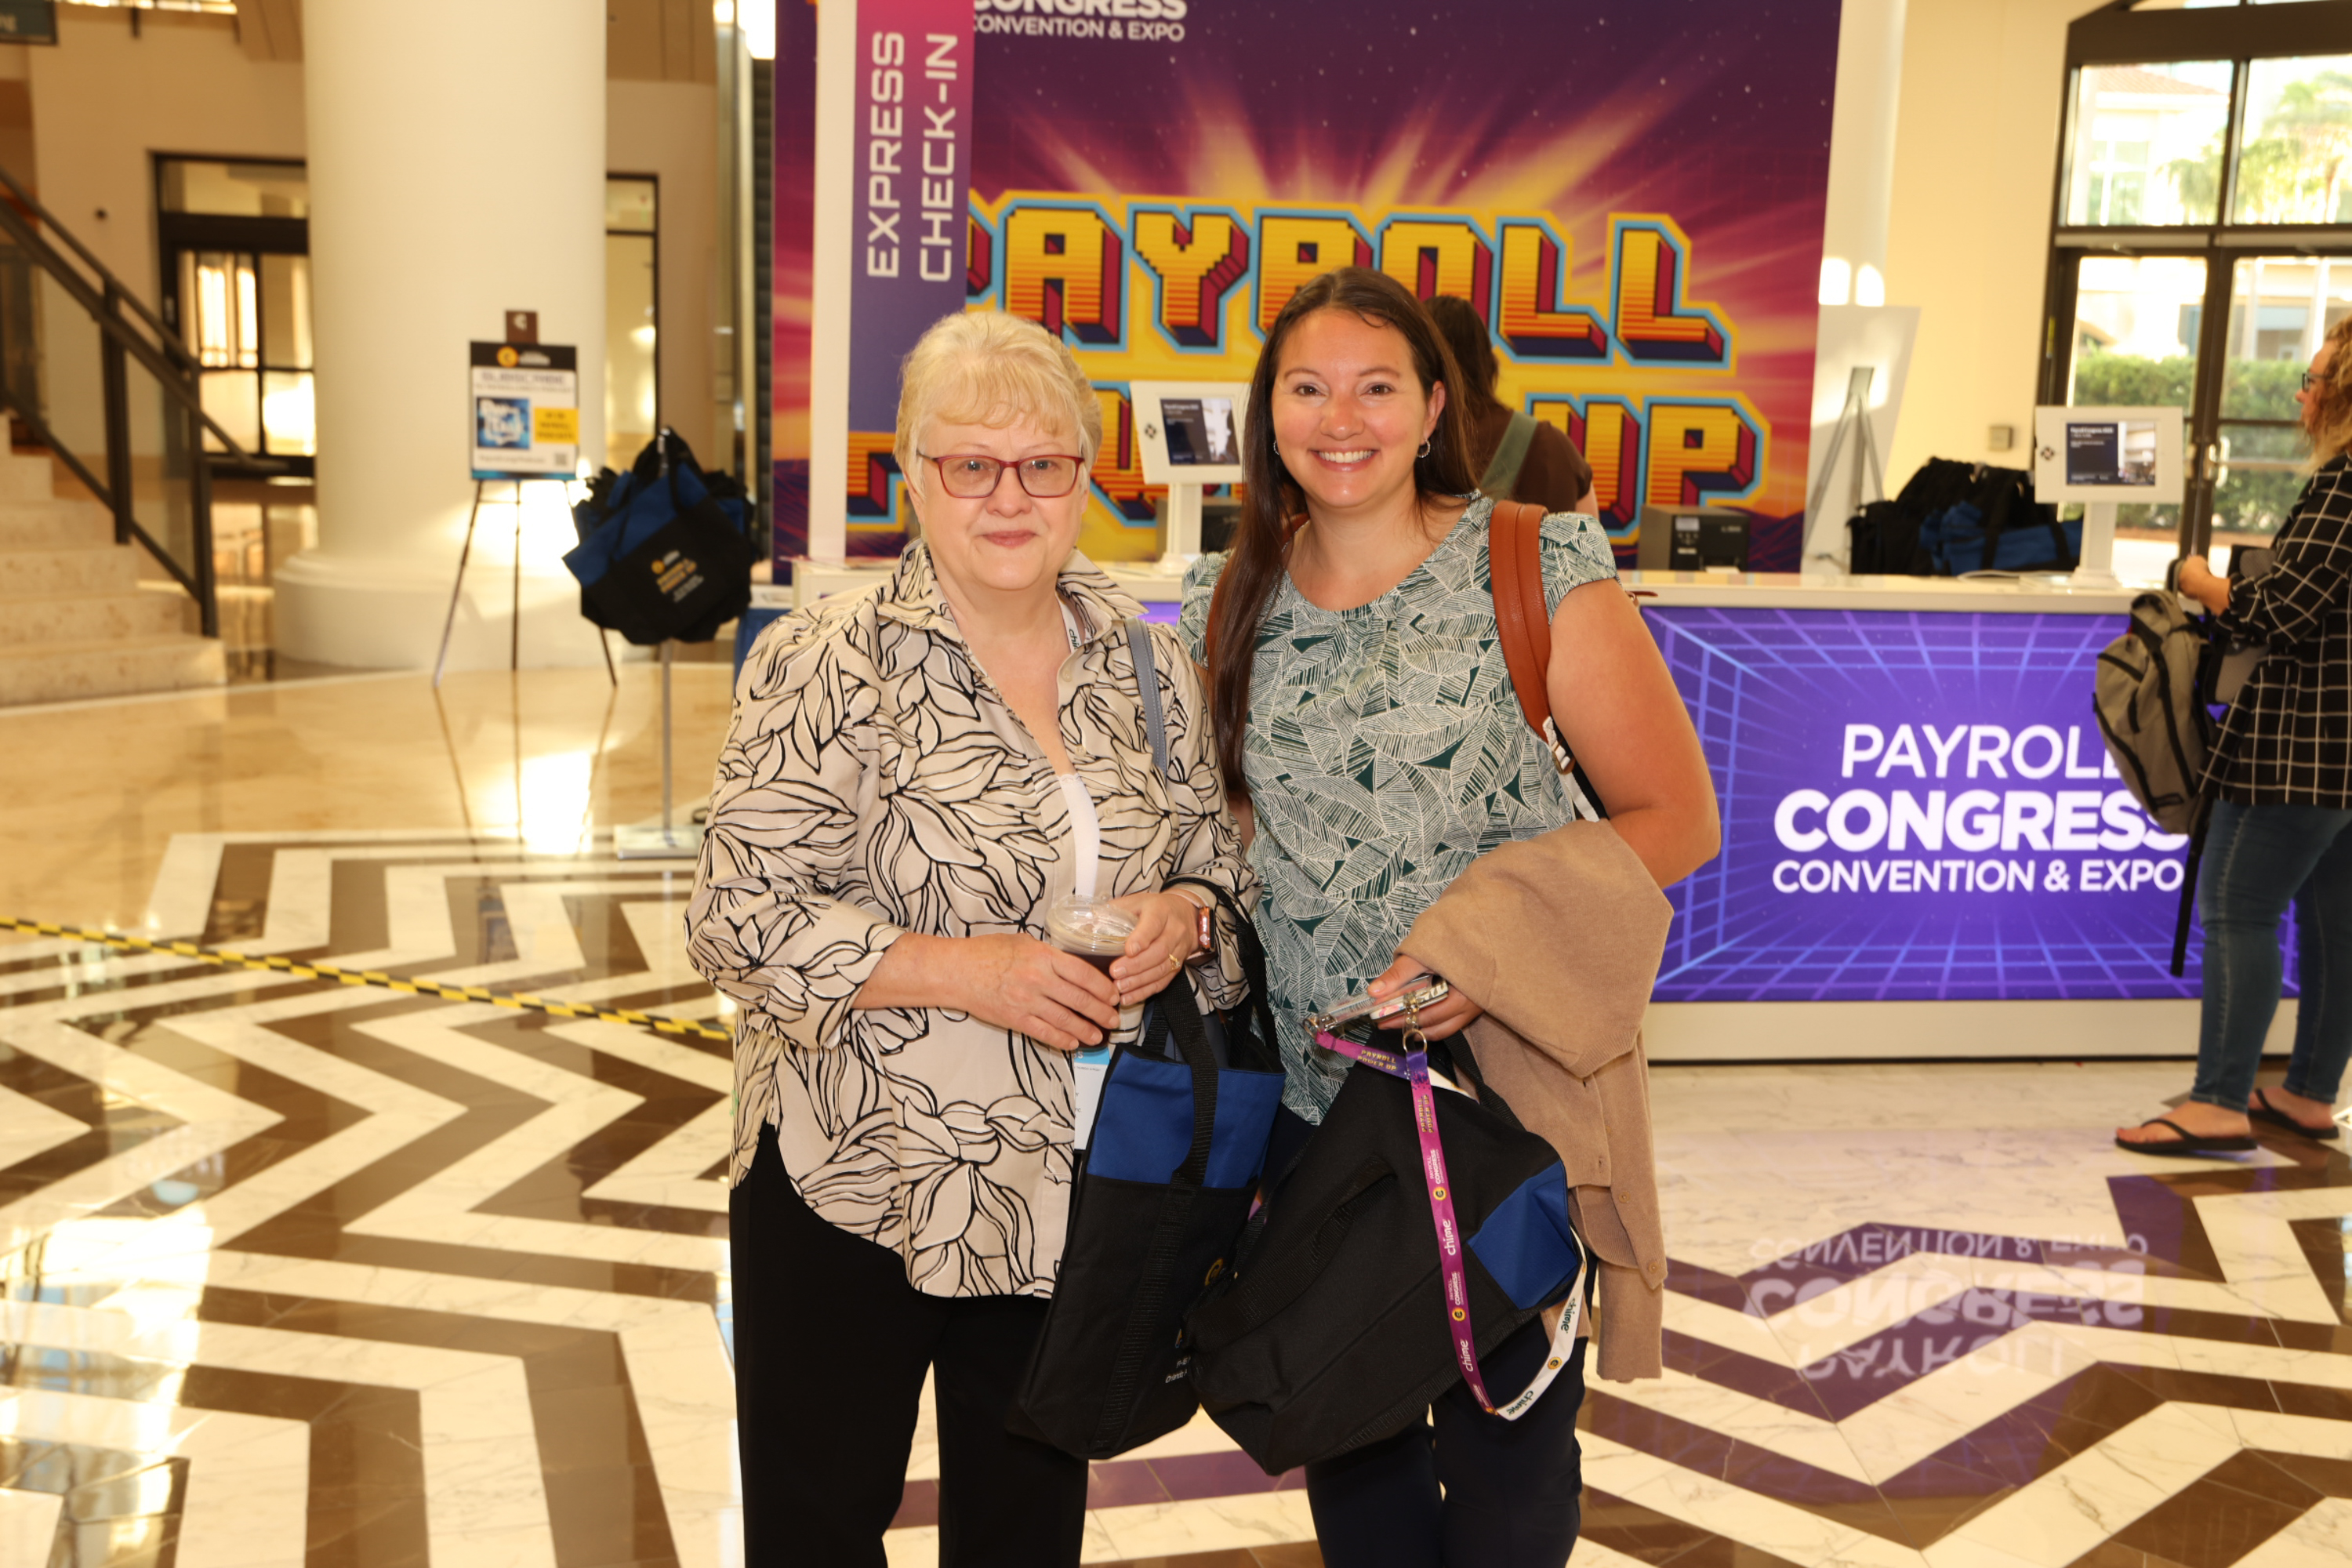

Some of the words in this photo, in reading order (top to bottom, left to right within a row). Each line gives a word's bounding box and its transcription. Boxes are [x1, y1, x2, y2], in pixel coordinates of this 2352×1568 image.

[973, 13, 1105, 38] ONVENTION
[1107, 19, 1123, 39] &
[1127, 20, 1186, 42] EXPO
[867, 31, 905, 278] EXPRESS
[920, 33, 958, 282] CHECK-IN
[968, 201, 1729, 364] AYROLL
[1772, 858, 2036, 894] CONVENTION
[2042, 858, 2071, 892] &
[2079, 858, 2185, 892] EXPO
[1360, 1049, 1397, 1064] PAYROLL
[1417, 1097, 1427, 1133] PAYROLL
[1443, 1218, 1456, 1256] chime
[1561, 1298, 1577, 1334] chime
[1460, 1338, 1474, 1372] chime
[1506, 1389, 1534, 1417] chime
